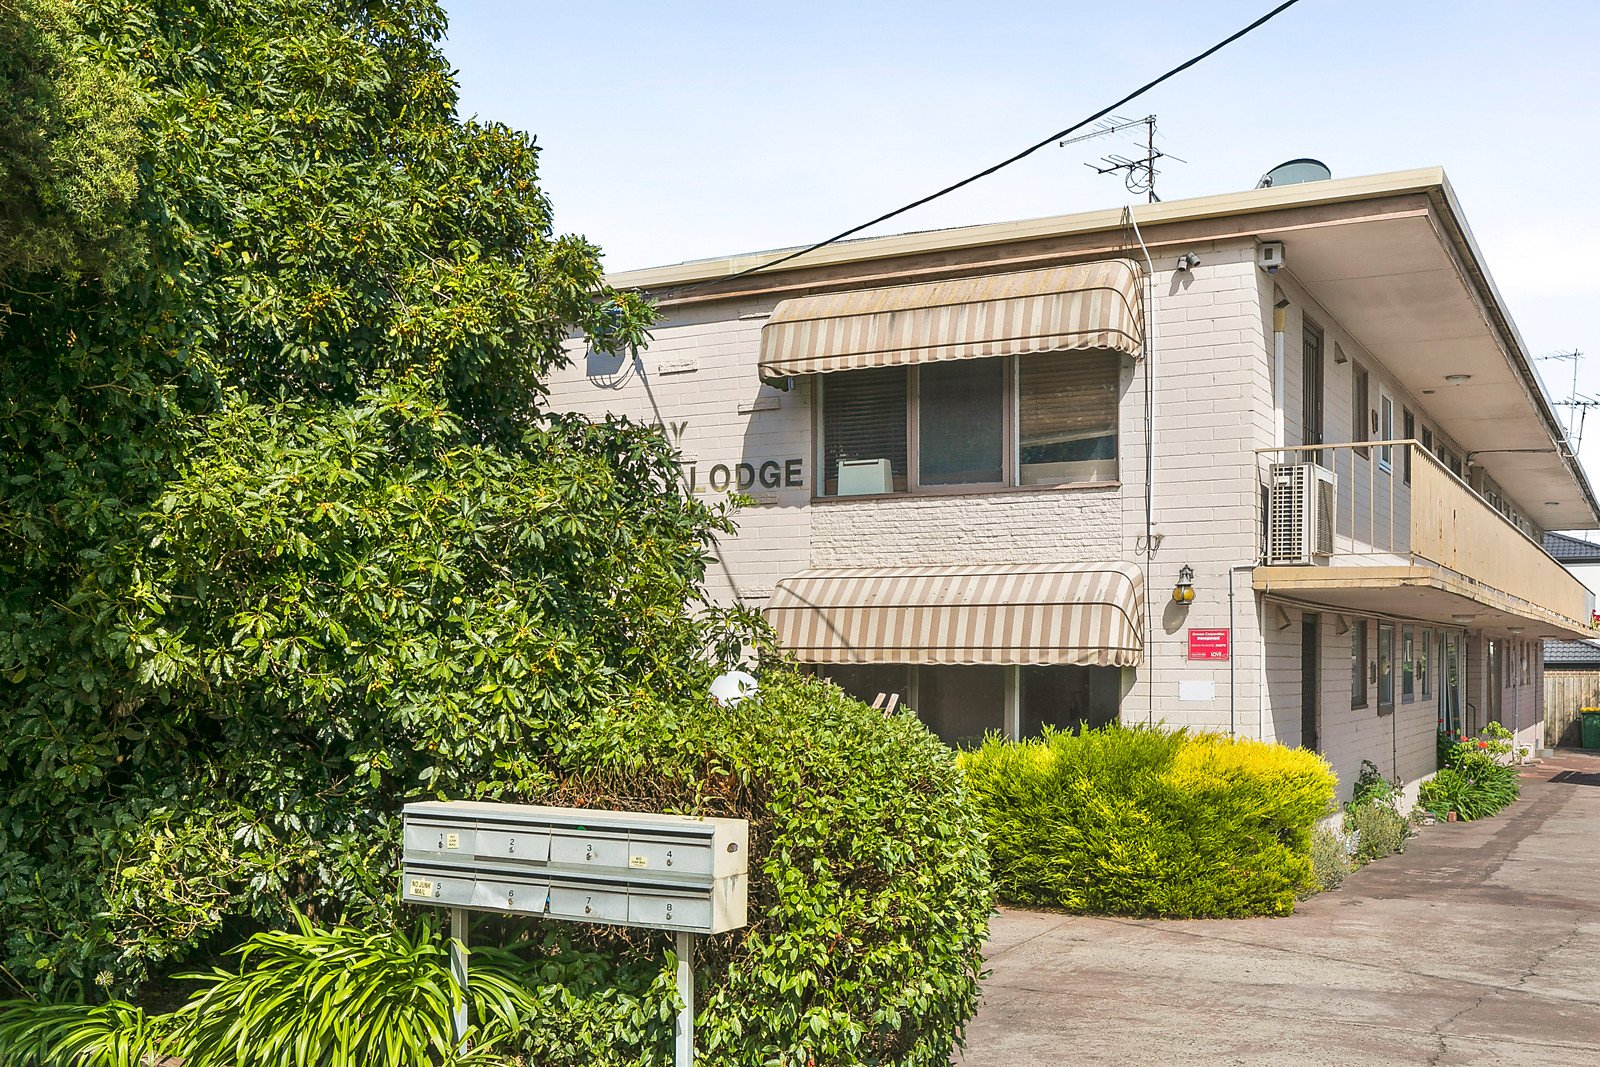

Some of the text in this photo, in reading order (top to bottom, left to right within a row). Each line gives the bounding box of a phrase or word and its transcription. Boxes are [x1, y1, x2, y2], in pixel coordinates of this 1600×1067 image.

[690, 458, 804, 493] LODGE
[509, 838, 515, 846] 2
[587, 844, 592, 852] 3
